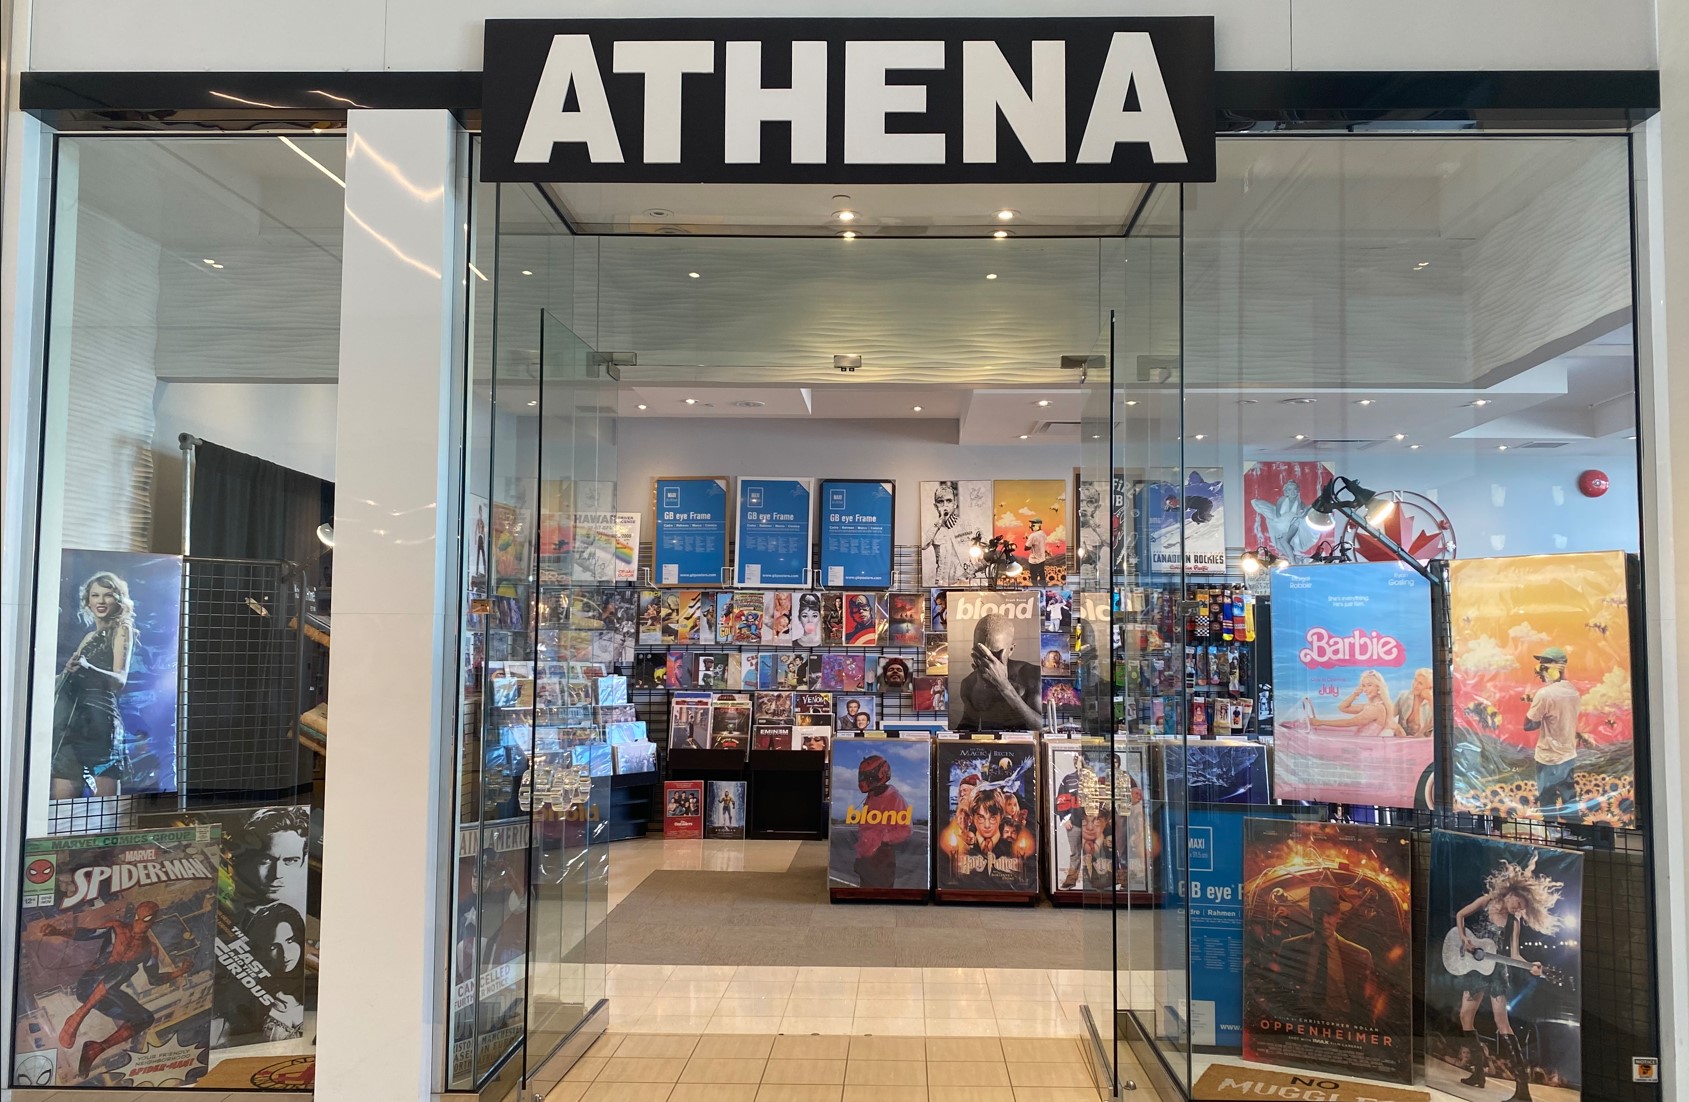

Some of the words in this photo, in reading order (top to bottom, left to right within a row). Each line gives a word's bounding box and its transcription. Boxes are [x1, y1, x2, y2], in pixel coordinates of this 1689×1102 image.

[514, 32, 1188, 164] ATHENA
[664, 511, 674, 520] GB
[676, 512, 688, 522] eye
[690, 511, 711, 520] Frame
[747, 511, 757, 520] GB
[759, 513, 771, 522] eye
[773, 512, 795, 521] Frame
[829, 513, 840, 522] GB
[841, 515, 854, 524] eye
[855, 514, 877, 522] Frame
[1152, 553, 1192, 564] CANADIN
[1194, 554, 1224, 564] ROCKIES
[1387, 578, 1415, 586] Gosling
[956, 597, 1034, 620] blond
[1299, 627, 1399, 663] Barbie
[1318, 683, 1340, 698] July
[802, 694, 828, 705] VENOM
[960, 749, 988, 757] MAGIC
[846, 803, 914, 826] blond
[52, 838, 99, 851] MARVEL
[103, 835, 148, 846] COMICS
[152, 831, 192, 842] GROUP
[1187, 837, 1205, 849] MAXI
[125, 849, 156, 862] MARVEL
[59, 858, 214, 911] SPIDER-MAN
[1178, 880, 1202, 898] GB
[1206, 885, 1232, 903] eye
[1207, 909, 1236, 917] Rahmen
[231, 926, 250, 943] THE
[227, 939, 272, 978] FAST
[228, 951, 244, 966] AND
[1219, 1023, 1242, 1031] www.
[1299, 1017, 1350, 1029] CHRISTOPHER
[1260, 1019, 1393, 1047] OPPENHEIMER
[137, 1053, 156, 1062] YOUR
[158, 1049, 191, 1059] FRIENDLY
[1217, 1077, 1396, 1101] MUGGL
[1290, 1076, 1340, 1090] NO
